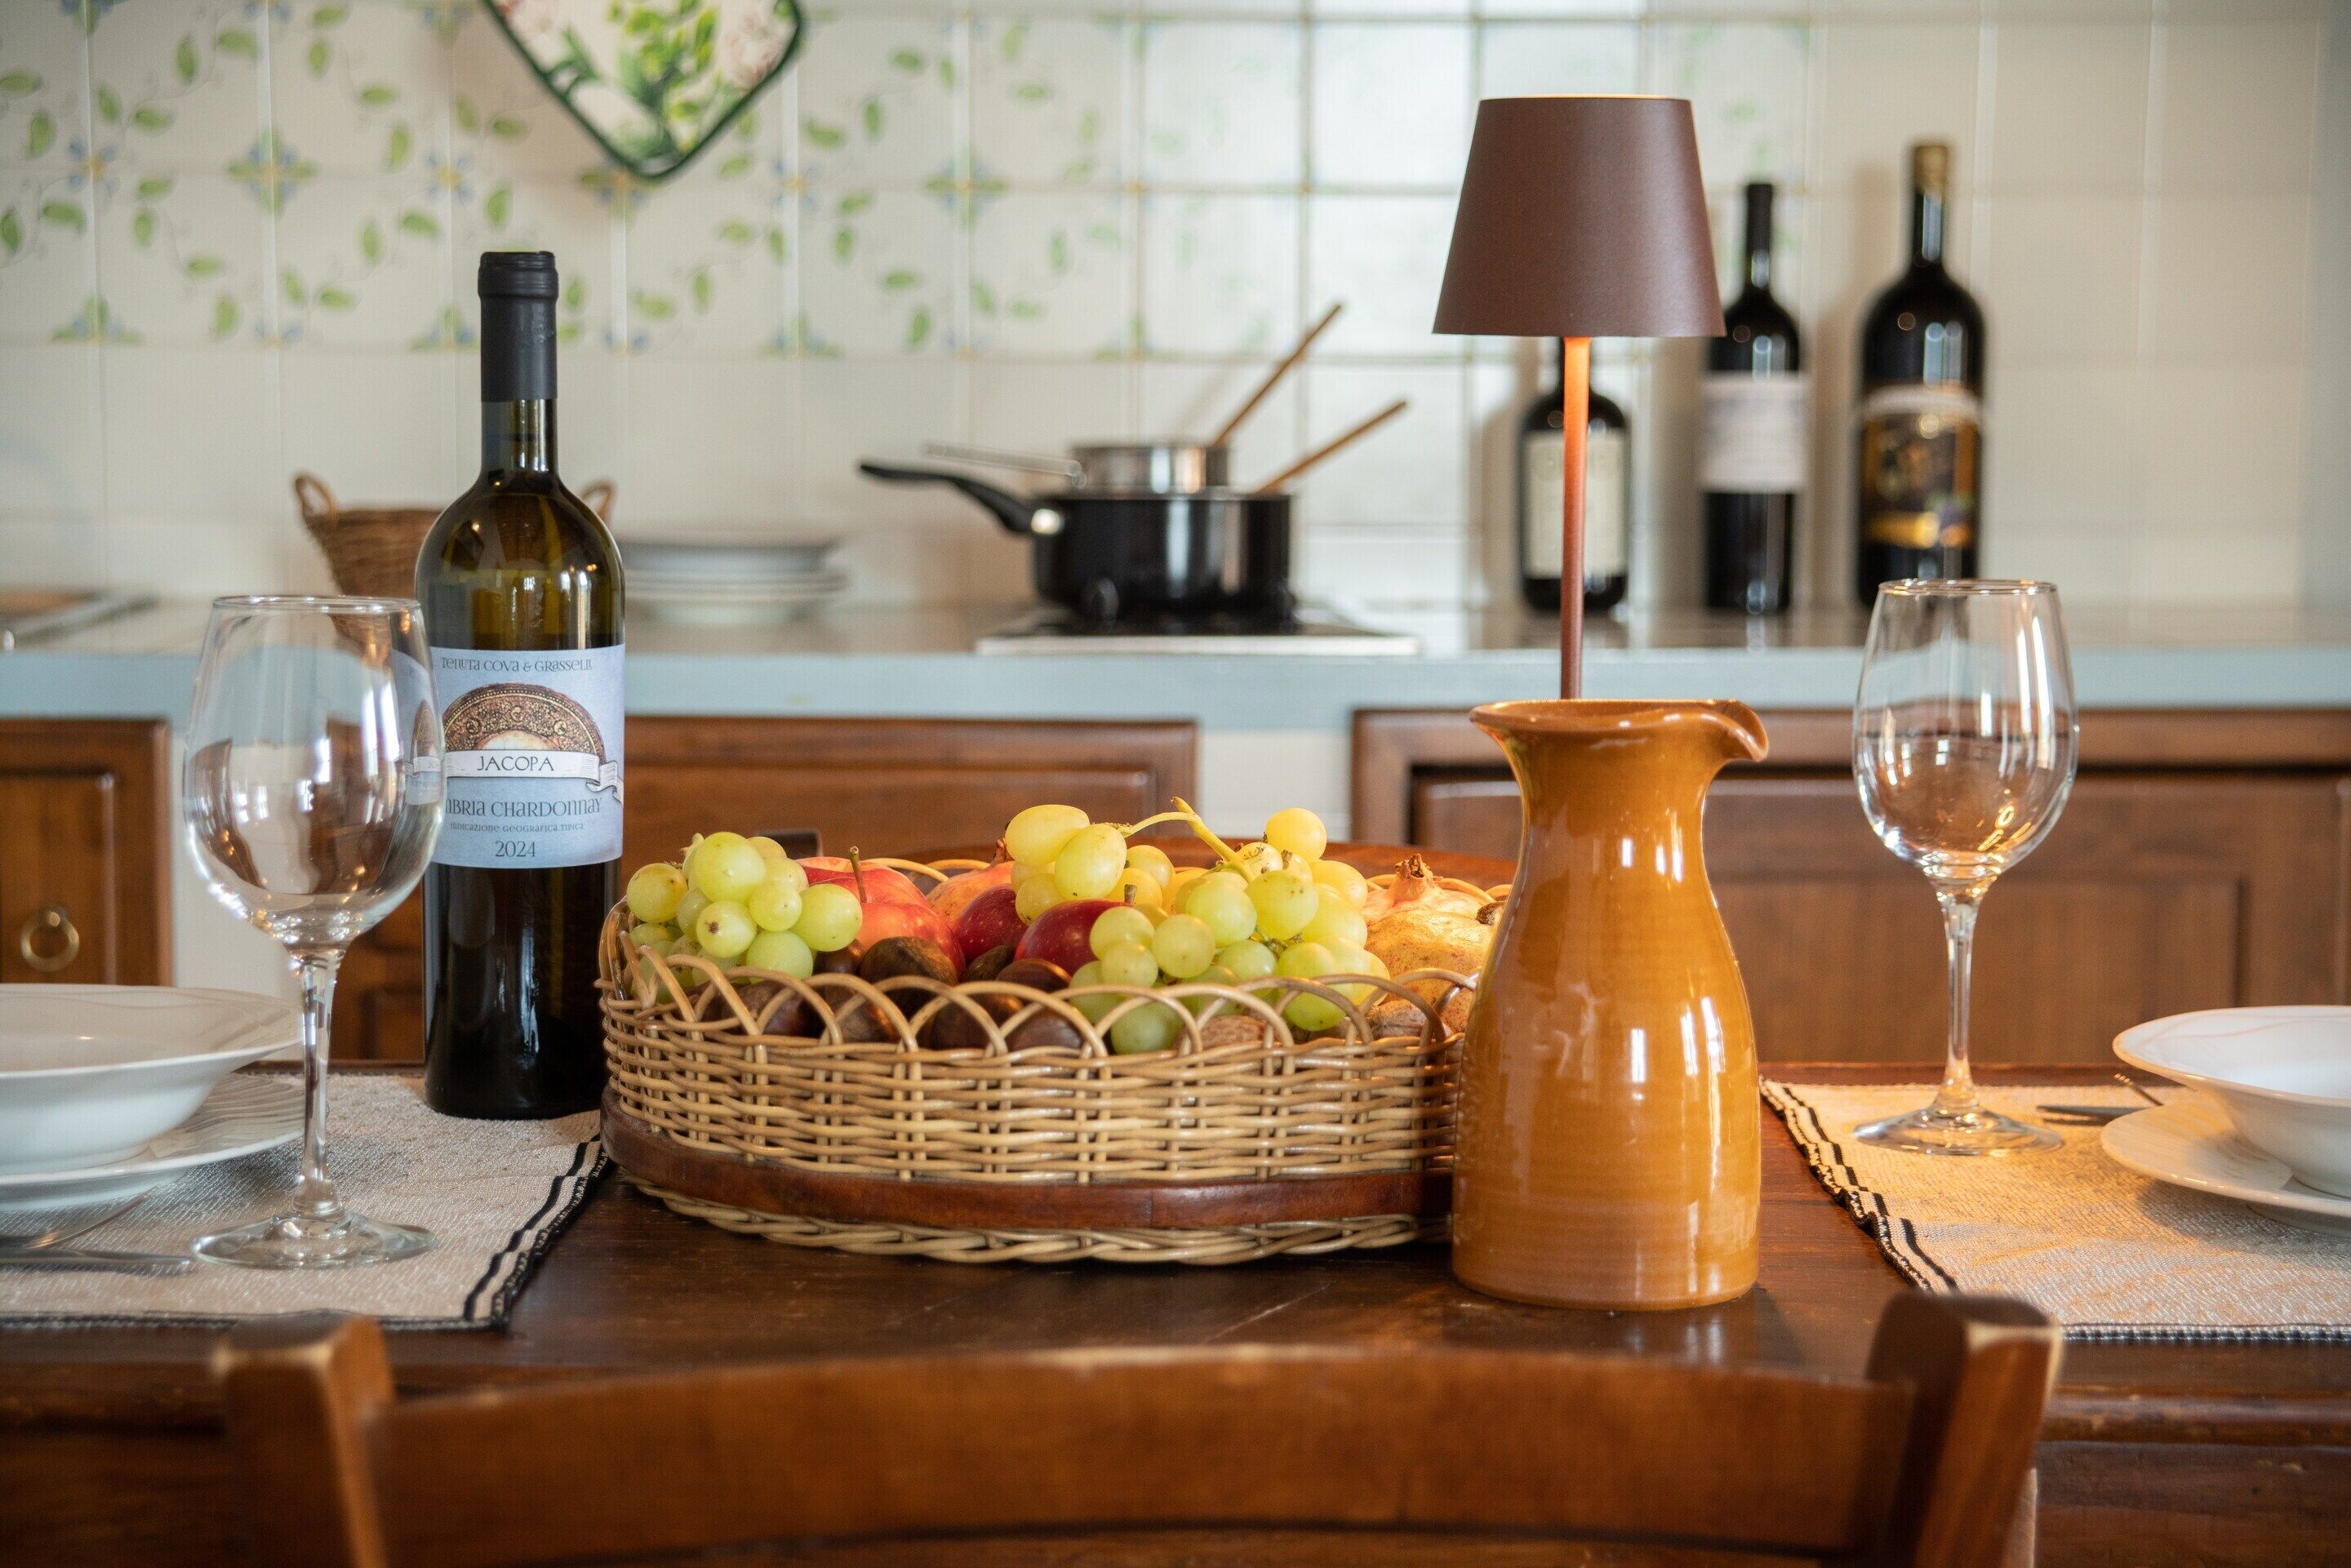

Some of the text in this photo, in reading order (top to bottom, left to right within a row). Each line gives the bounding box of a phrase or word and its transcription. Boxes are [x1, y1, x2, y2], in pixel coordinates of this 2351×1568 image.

[522, 662, 532, 672] &
[477, 756, 554, 771] JACOPA
[496, 841, 536, 857] 2024
